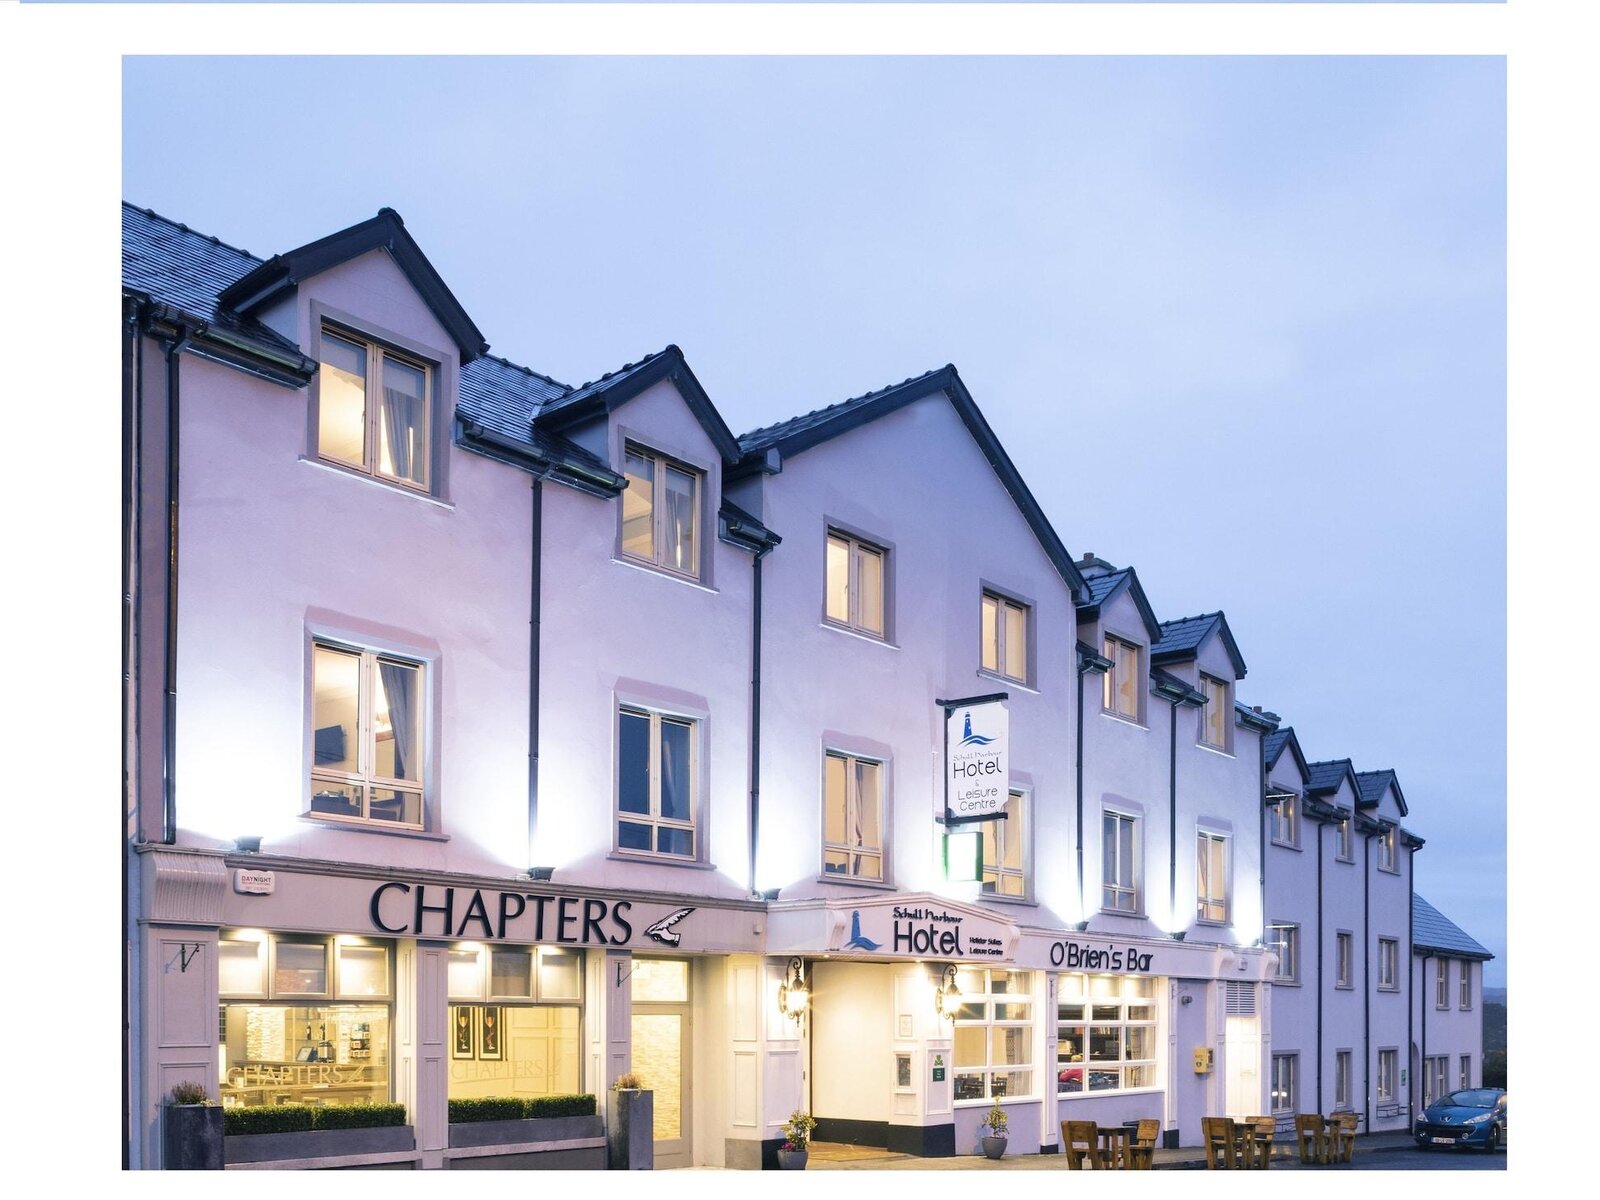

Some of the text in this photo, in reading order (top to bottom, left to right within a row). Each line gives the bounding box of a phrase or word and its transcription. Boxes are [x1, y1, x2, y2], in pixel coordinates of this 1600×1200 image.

[953, 757, 1002, 779] Hotel
[958, 788, 998, 800] Leisure
[960, 799, 996, 811] Centre
[369, 882, 632, 945] CHAPTERS
[893, 906, 923, 919] Schull
[894, 920, 964, 956] Hotel
[1050, 941, 1154, 971] O'Brien's Bar
[226, 1065, 343, 1087] CHAPTERS
[451, 1060, 544, 1080] CHAPTERS
